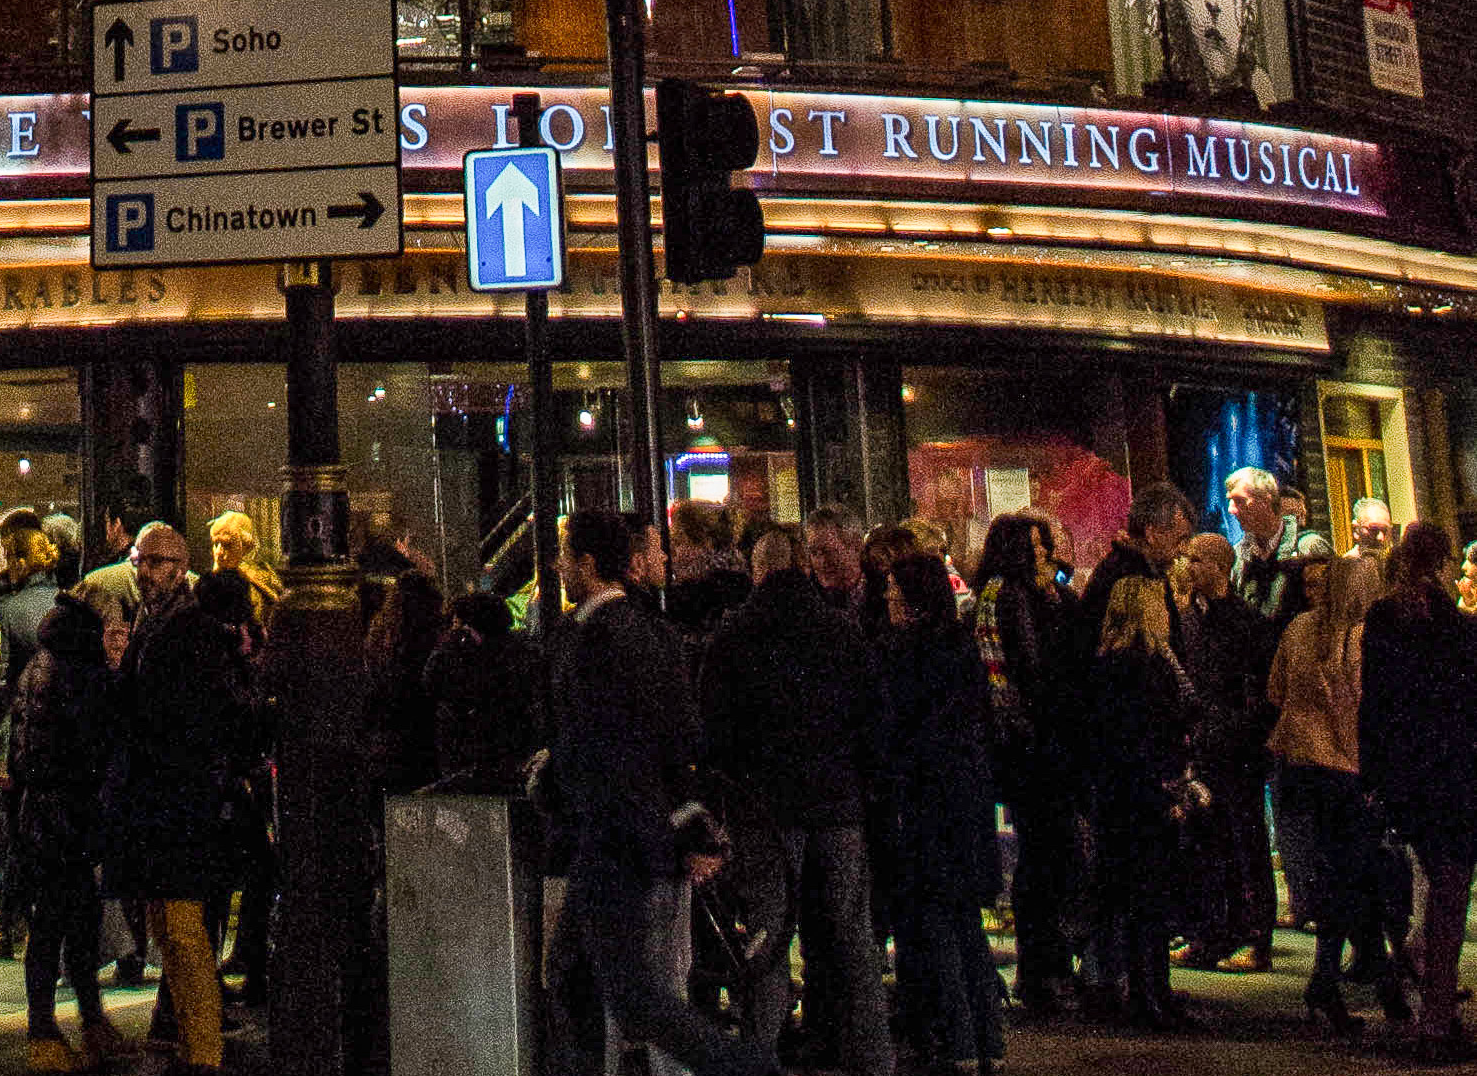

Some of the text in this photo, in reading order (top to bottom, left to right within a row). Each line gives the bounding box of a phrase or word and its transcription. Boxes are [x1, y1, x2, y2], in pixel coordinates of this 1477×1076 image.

[213, 26, 281, 54] Soho
[238, 115, 339, 142] Brewer
[351, 108, 384, 135] St
[882, 112, 1160, 173] RUNNING
[1186, 133, 1361, 196] MUSICAL
[165, 205, 318, 233] Chinatown
